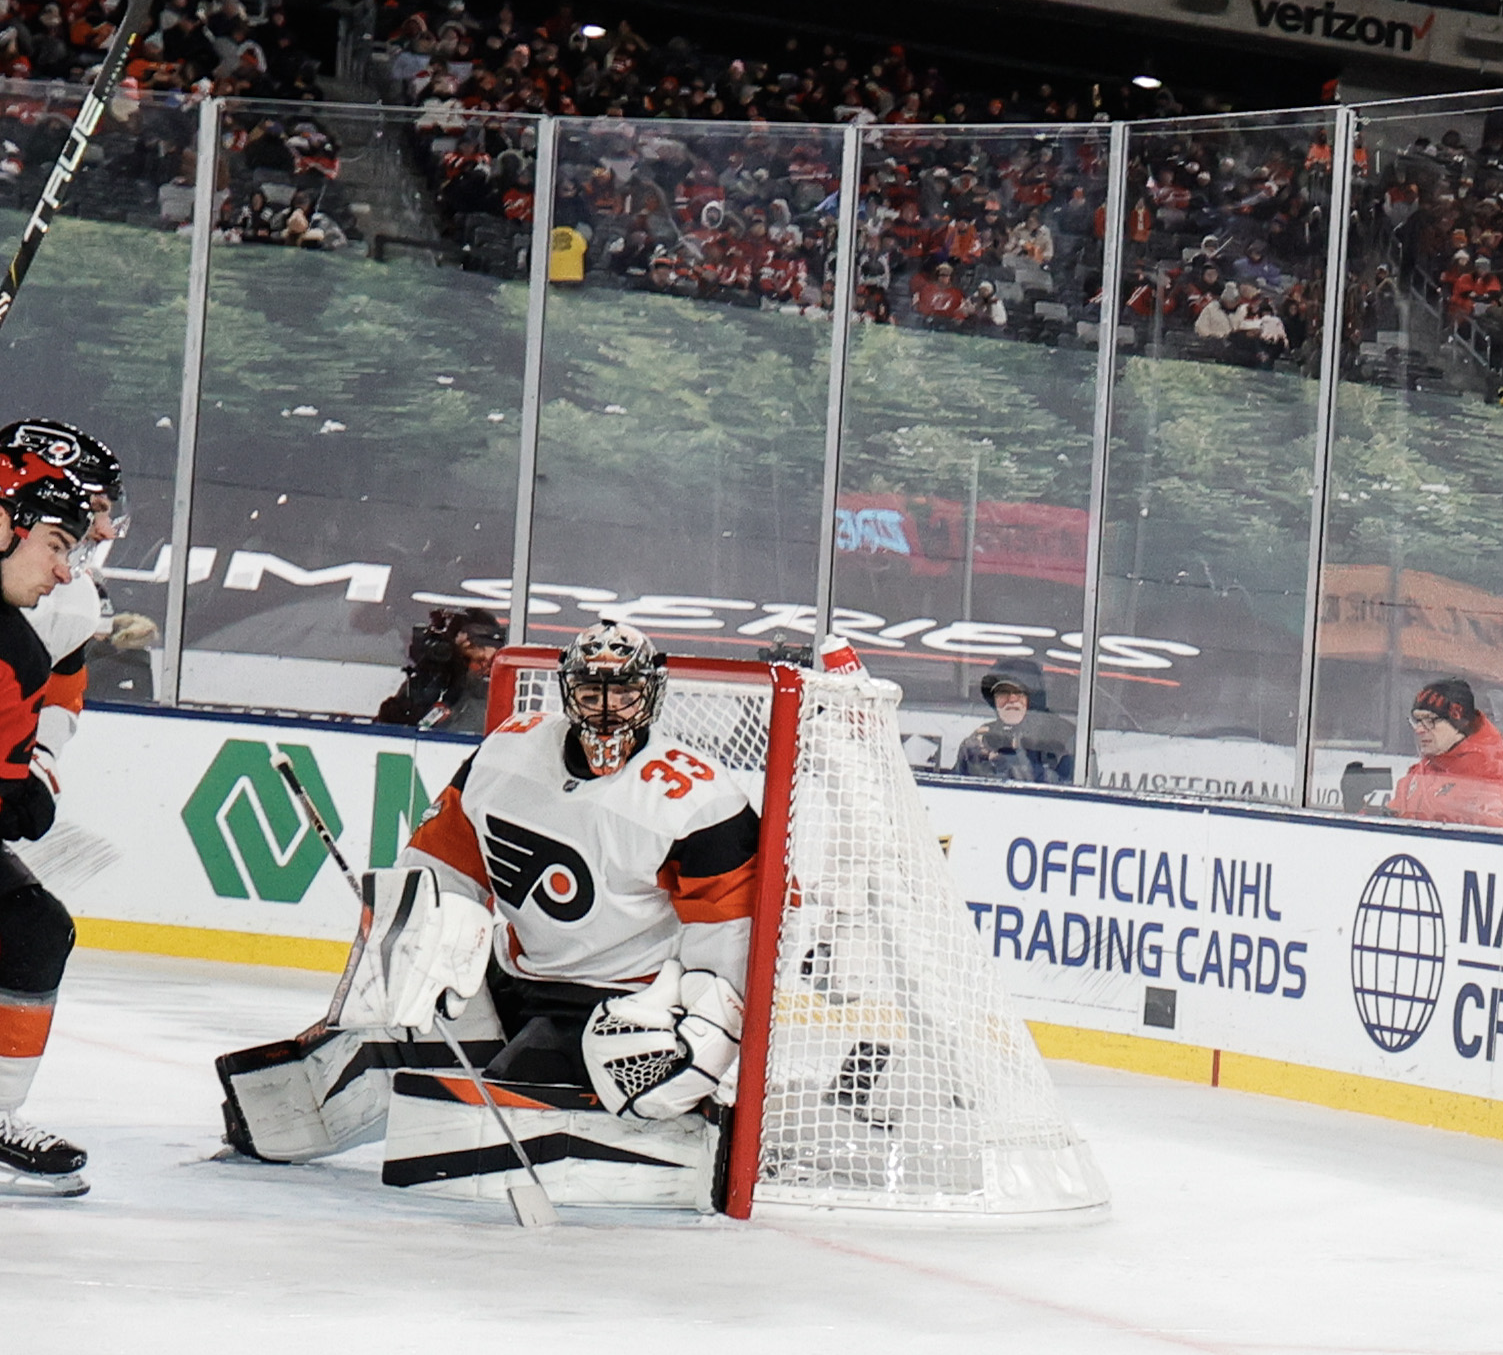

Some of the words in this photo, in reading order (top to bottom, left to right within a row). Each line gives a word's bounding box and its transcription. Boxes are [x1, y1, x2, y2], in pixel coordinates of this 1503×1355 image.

[410, 576, 1202, 669] SERIES
[588, 733, 624, 768] 33
[639, 748, 715, 800] 33
[1004, 836, 1198, 910] OFFICIAL
[1210, 855, 1282, 922] NHL
[966, 900, 1163, 979] TRADING
[1174, 925, 1309, 1000] CARDS
